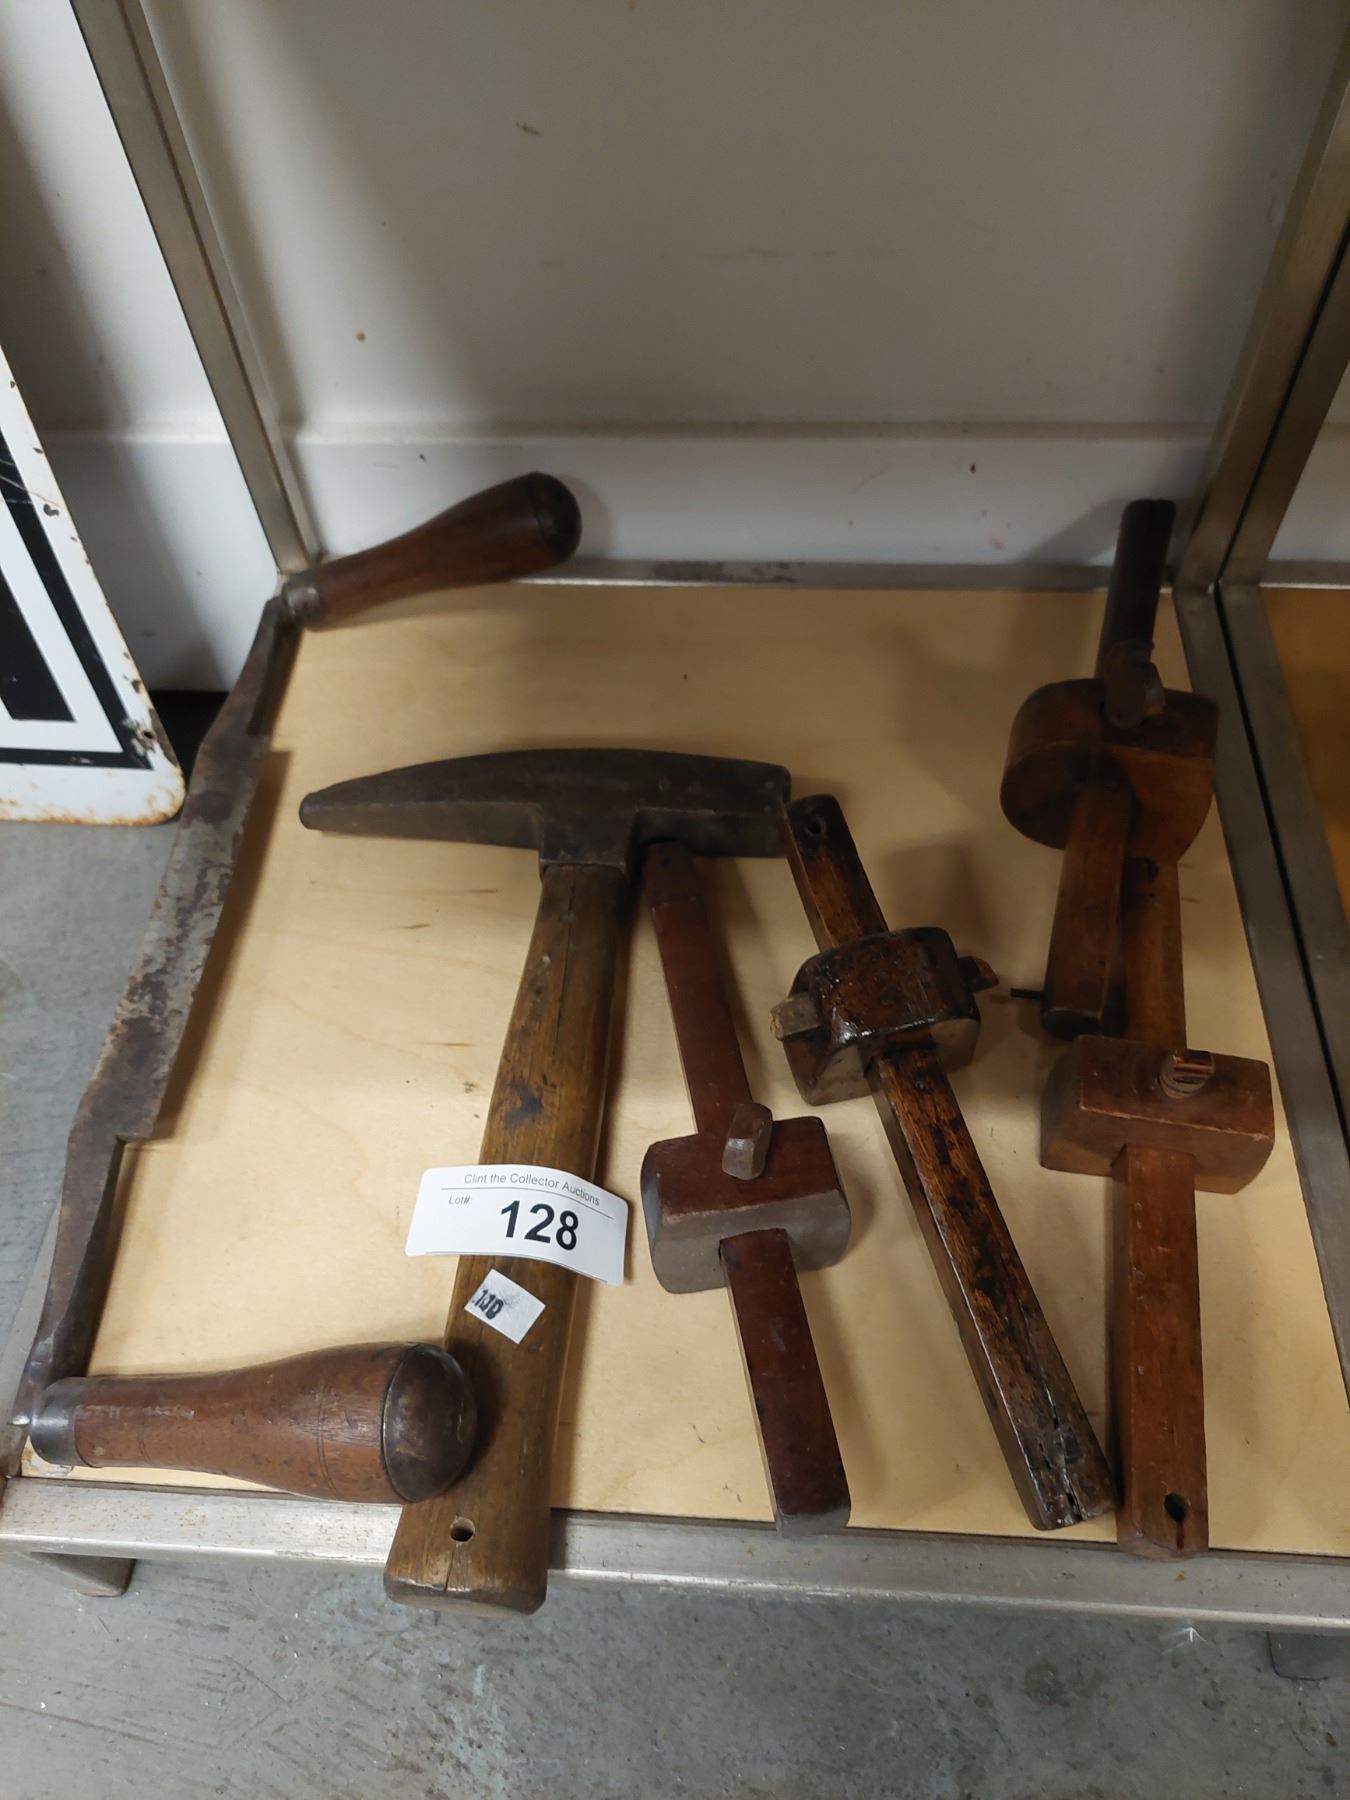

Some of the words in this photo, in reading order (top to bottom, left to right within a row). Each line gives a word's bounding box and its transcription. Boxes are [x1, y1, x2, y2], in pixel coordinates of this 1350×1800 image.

[464, 1173, 487, 1184] Clint
[490, 1173, 507, 1184] the
[510, 1172, 560, 1189] Collector
[562, 1180, 600, 1207] Auctions
[501, 1200, 579, 1251] 128
